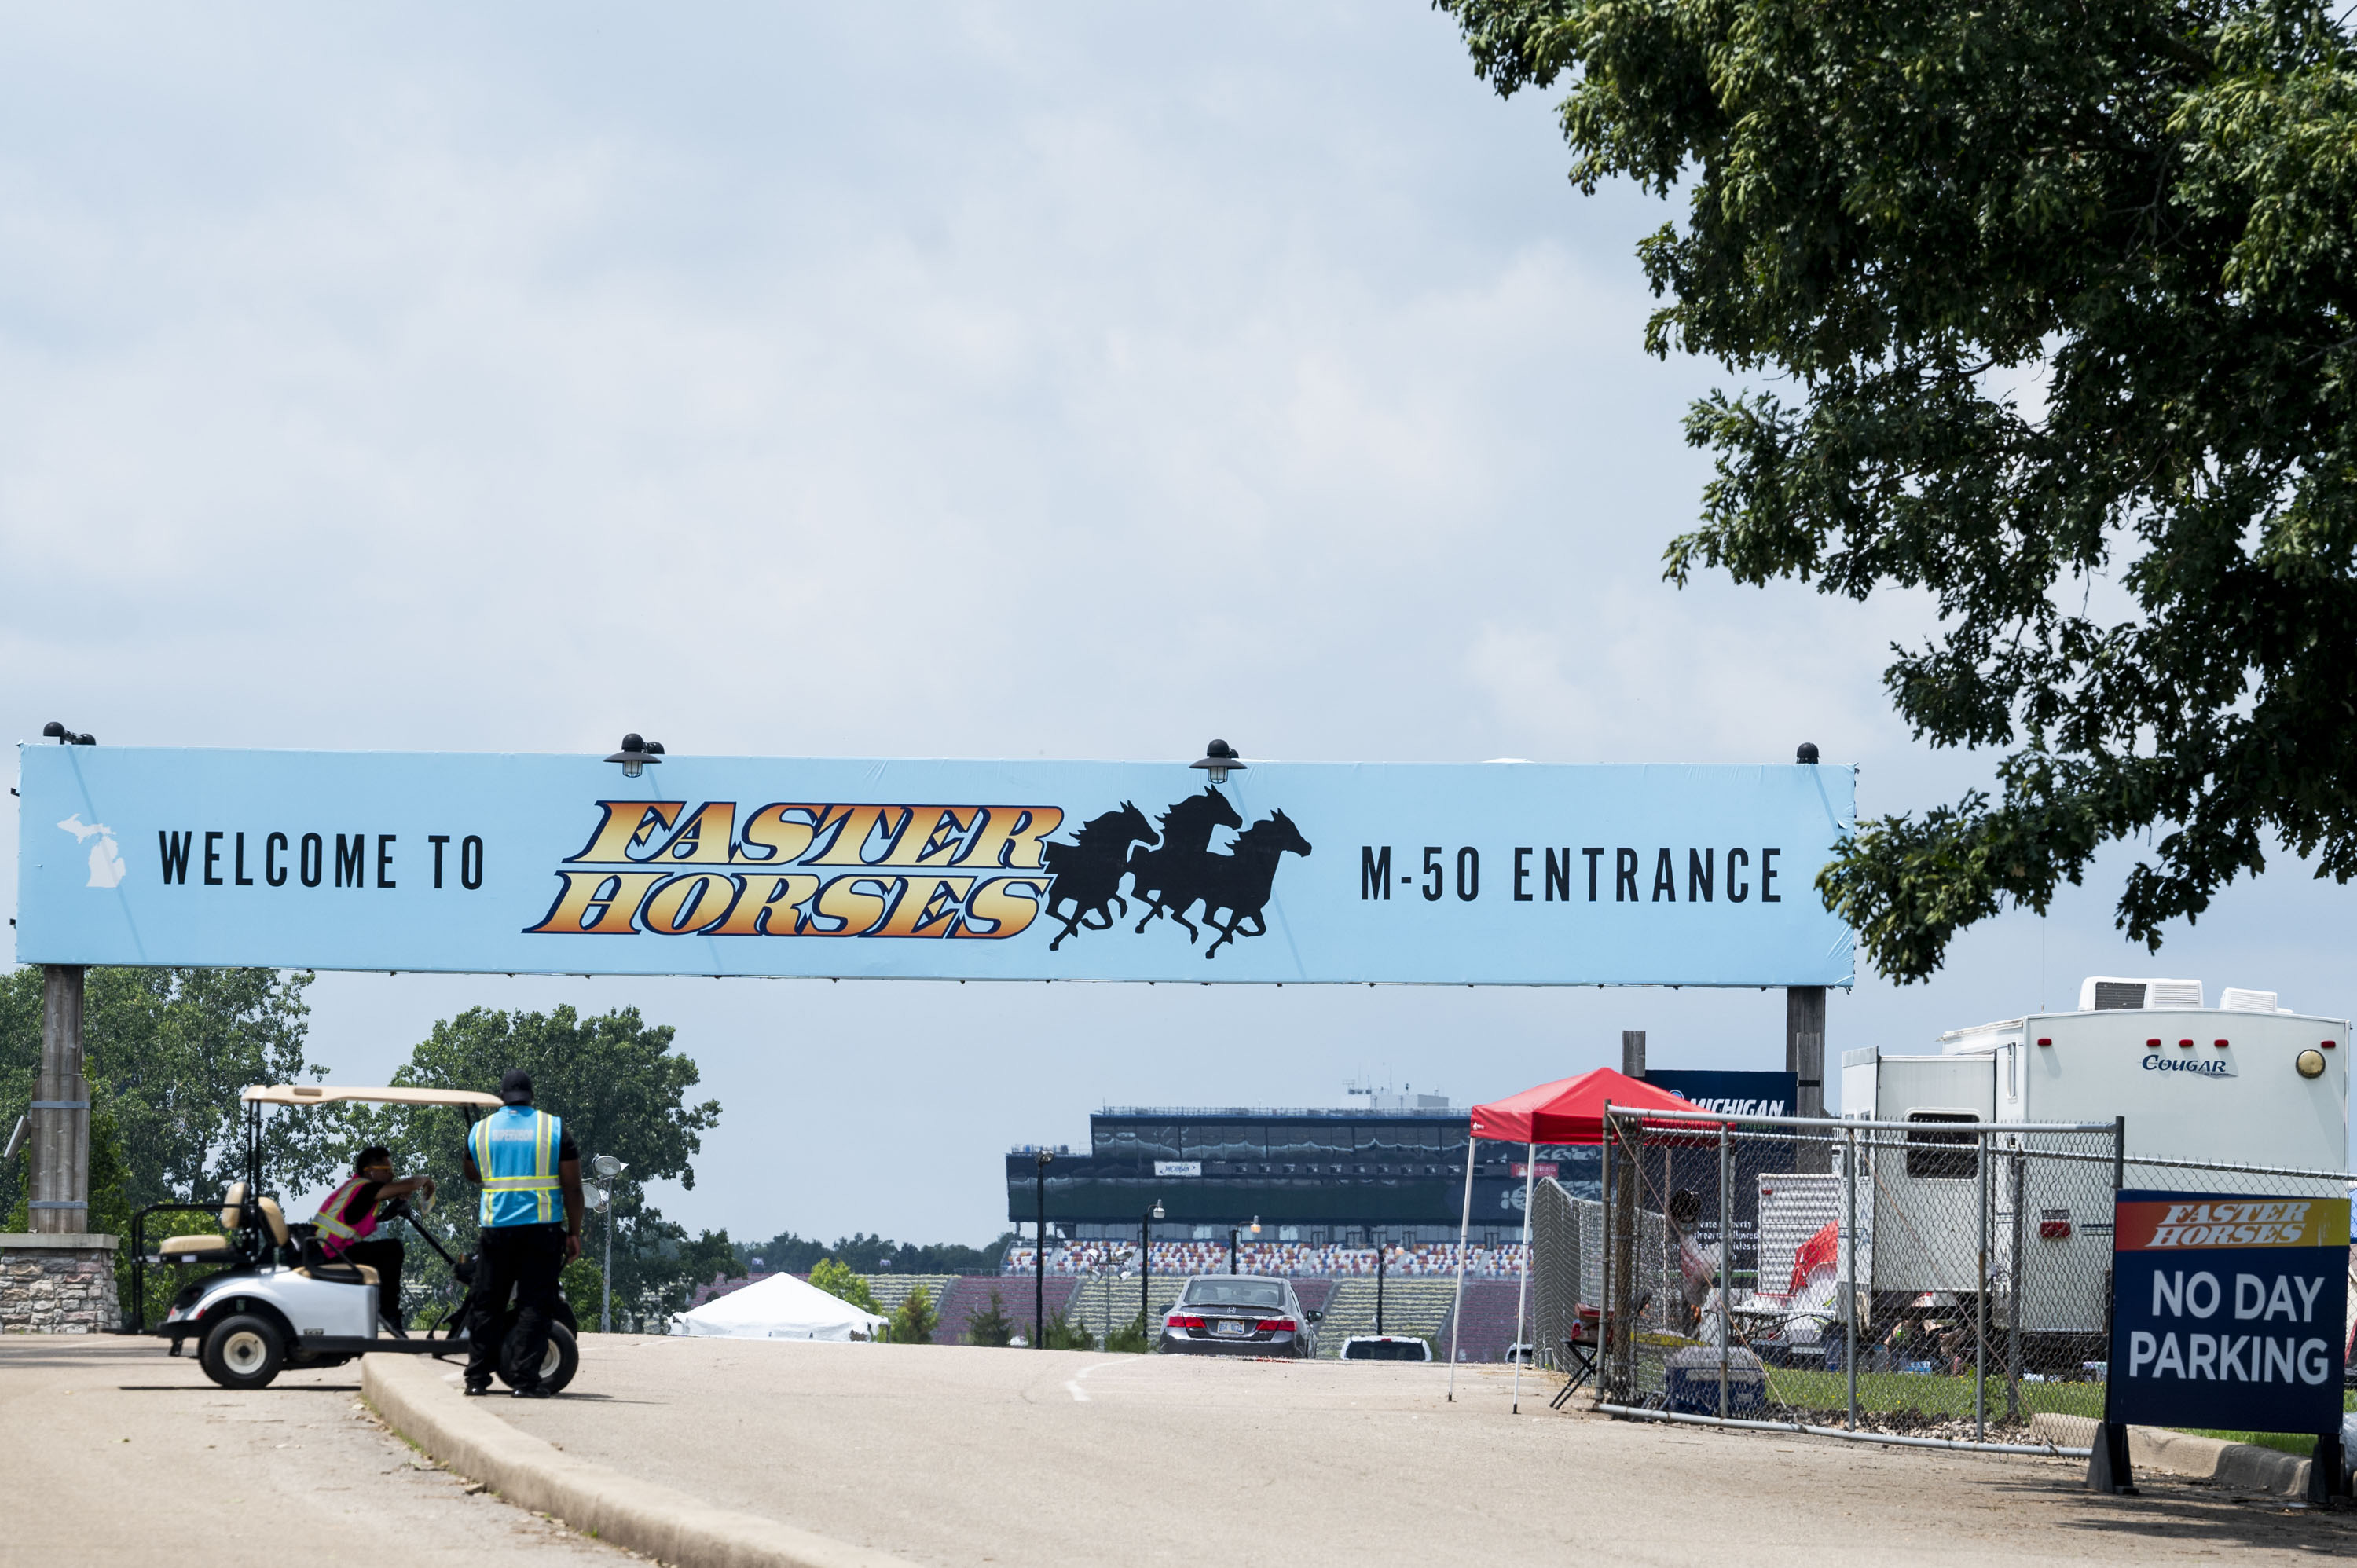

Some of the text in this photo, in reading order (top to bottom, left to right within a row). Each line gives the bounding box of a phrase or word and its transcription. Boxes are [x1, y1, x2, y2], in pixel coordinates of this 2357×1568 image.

[159, 830, 483, 890] WELCOME TO
[561, 800, 1065, 869] FASTER
[1362, 845, 1781, 903] M-50 ENTRANCE
[522, 870, 1053, 940] HORSES
[2145, 1223, 2306, 1247] HORSES
[2157, 1202, 2311, 1225] FASTER
[2152, 1269, 2325, 1322] NO DAY
[2129, 1331, 2329, 1385] PARKING
